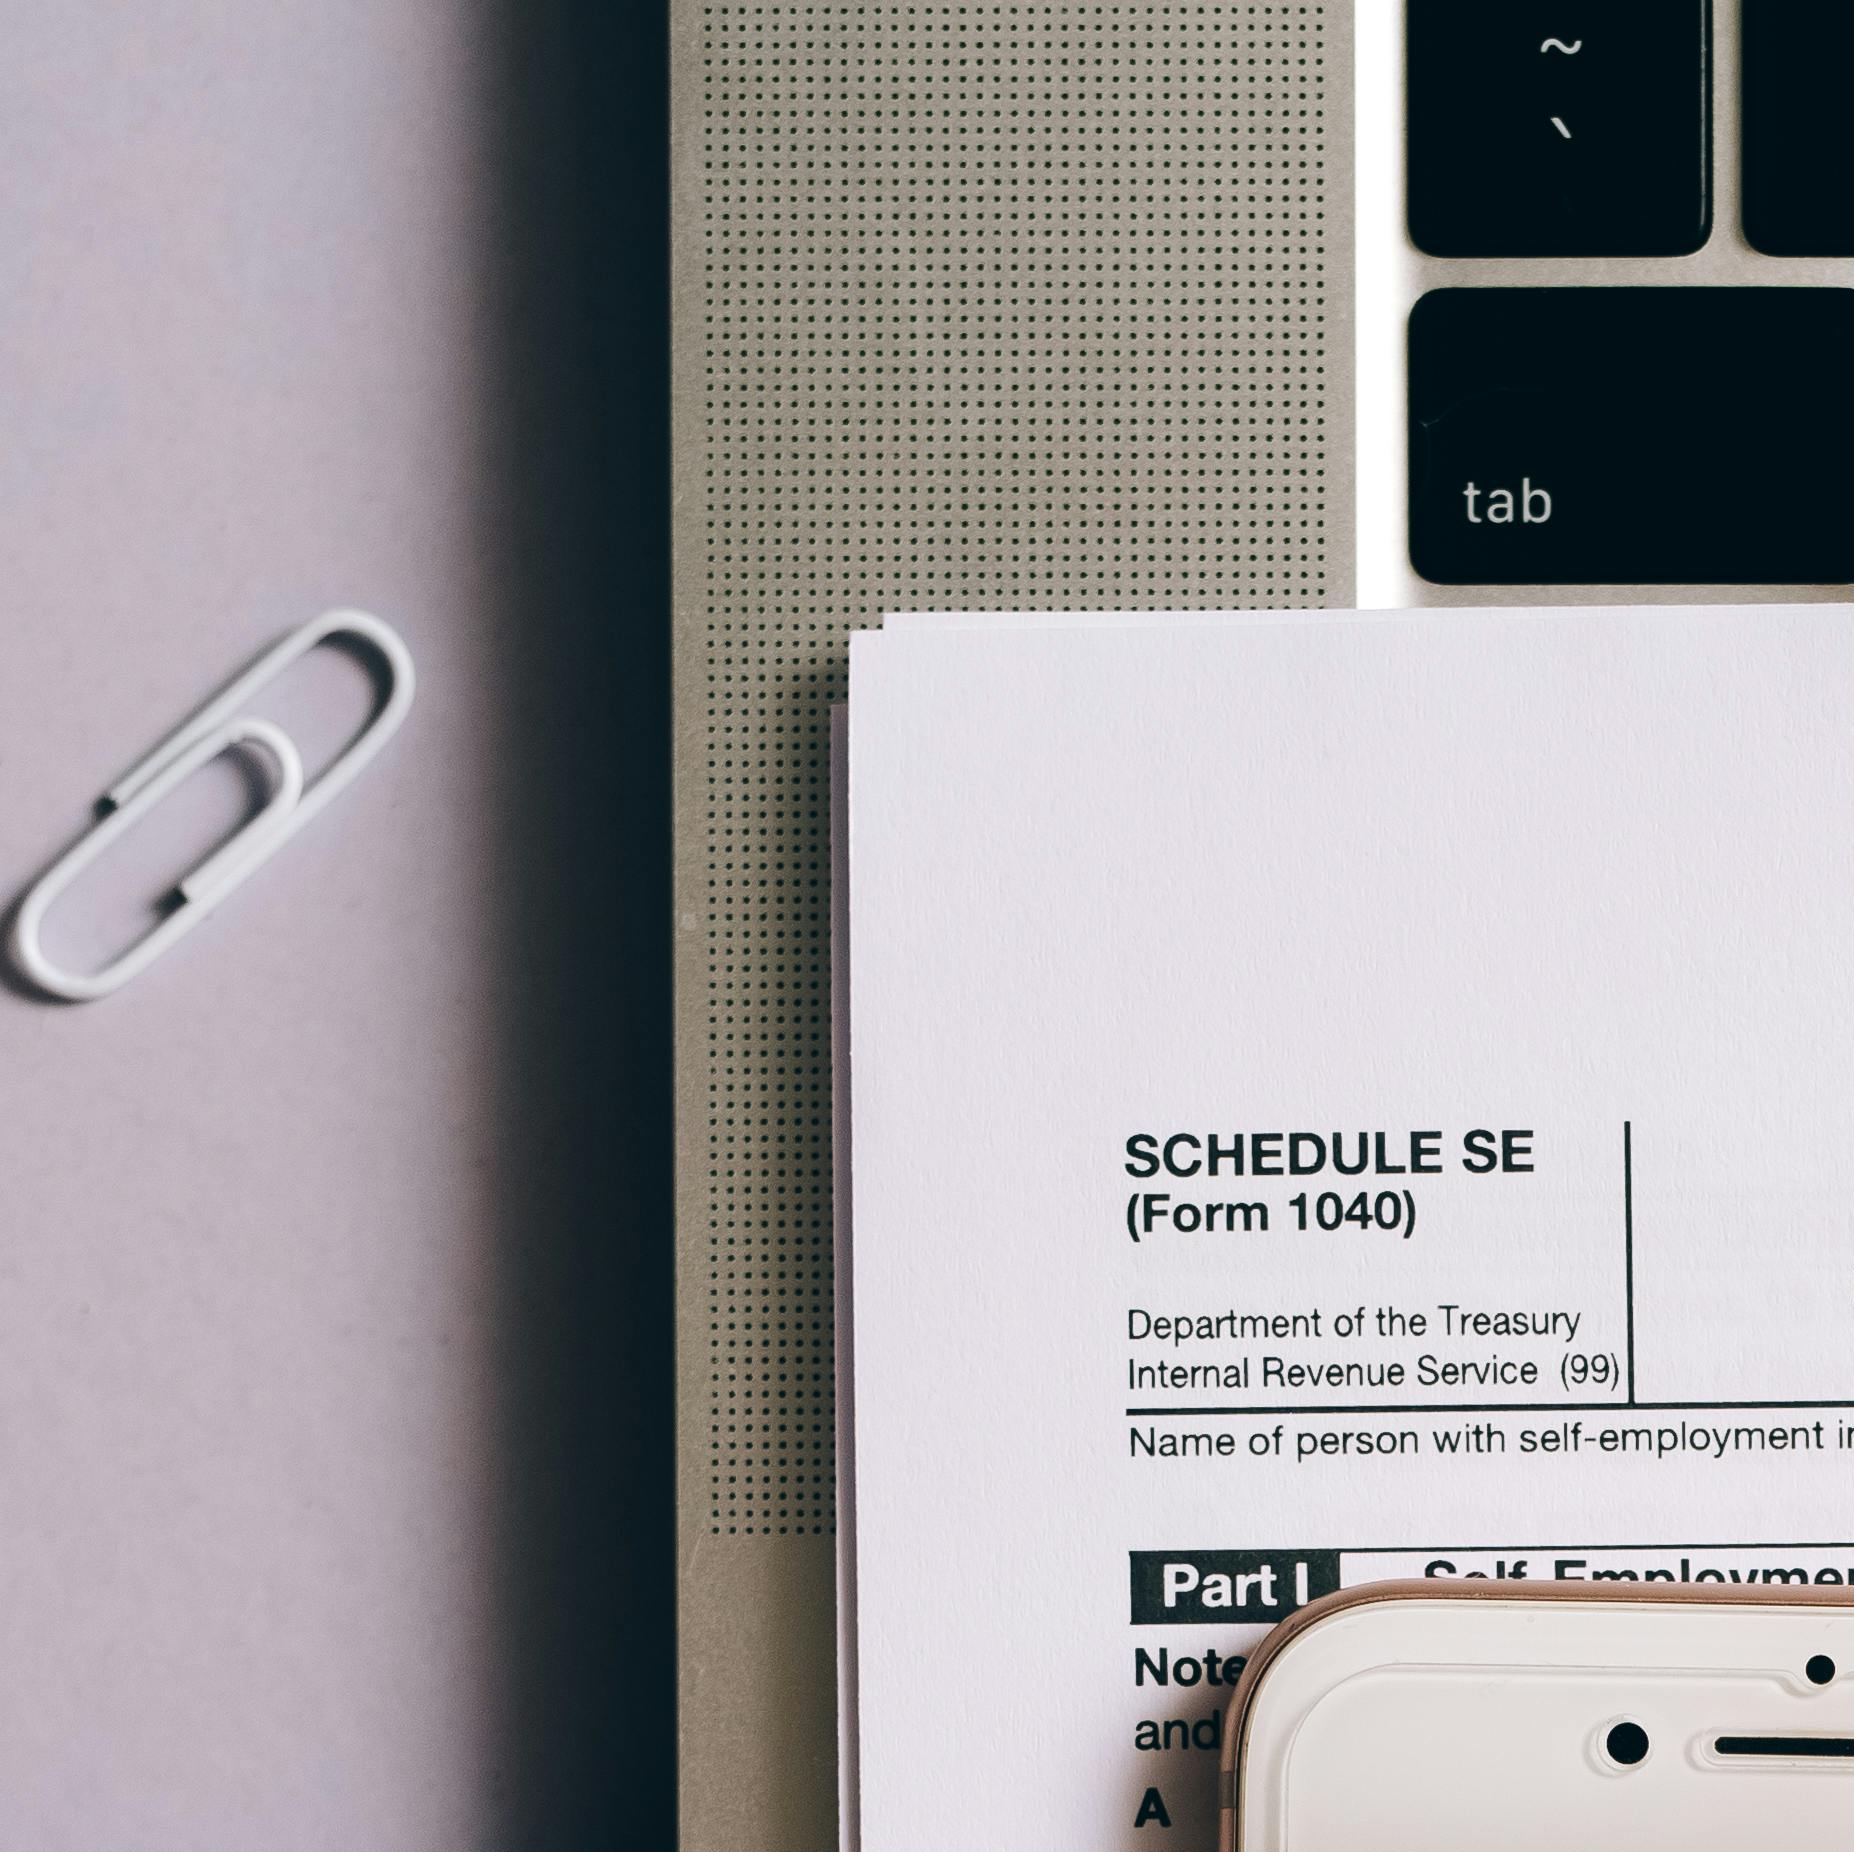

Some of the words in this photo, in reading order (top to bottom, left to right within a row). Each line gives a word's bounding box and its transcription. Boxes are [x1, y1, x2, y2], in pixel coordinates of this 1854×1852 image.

[1463, 478, 1551, 523] tab
[1125, 1131, 1442, 1178] SCHEDULE
[1463, 1129, 1534, 1173] SE
[1127, 1193, 1268, 1242] (Form
[1289, 1190, 1415, 1239] 1040)
[1129, 1309, 1321, 1347] Department
[1334, 1307, 1365, 1337] of
[1376, 1306, 1426, 1336] the
[1438, 1305, 1580, 1342] Treasury
[1130, 1357, 1248, 1389] Internal
[1263, 1357, 1404, 1387] Revenue
[1418, 1355, 1537, 1385] Service
[1561, 1353, 1619, 1391] (99)
[1131, 1427, 1235, 1456] Name
[1249, 1425, 1283, 1455] of
[1298, 1432, 1418, 1463] person
[1433, 1423, 1504, 1453] with
[1520, 1421, 1824, 1458] self-employment
[1164, 1564, 1277, 1607] Part
[1135, 1710, 1220, 1751] and
[1134, 1787, 1172, 1828] A
